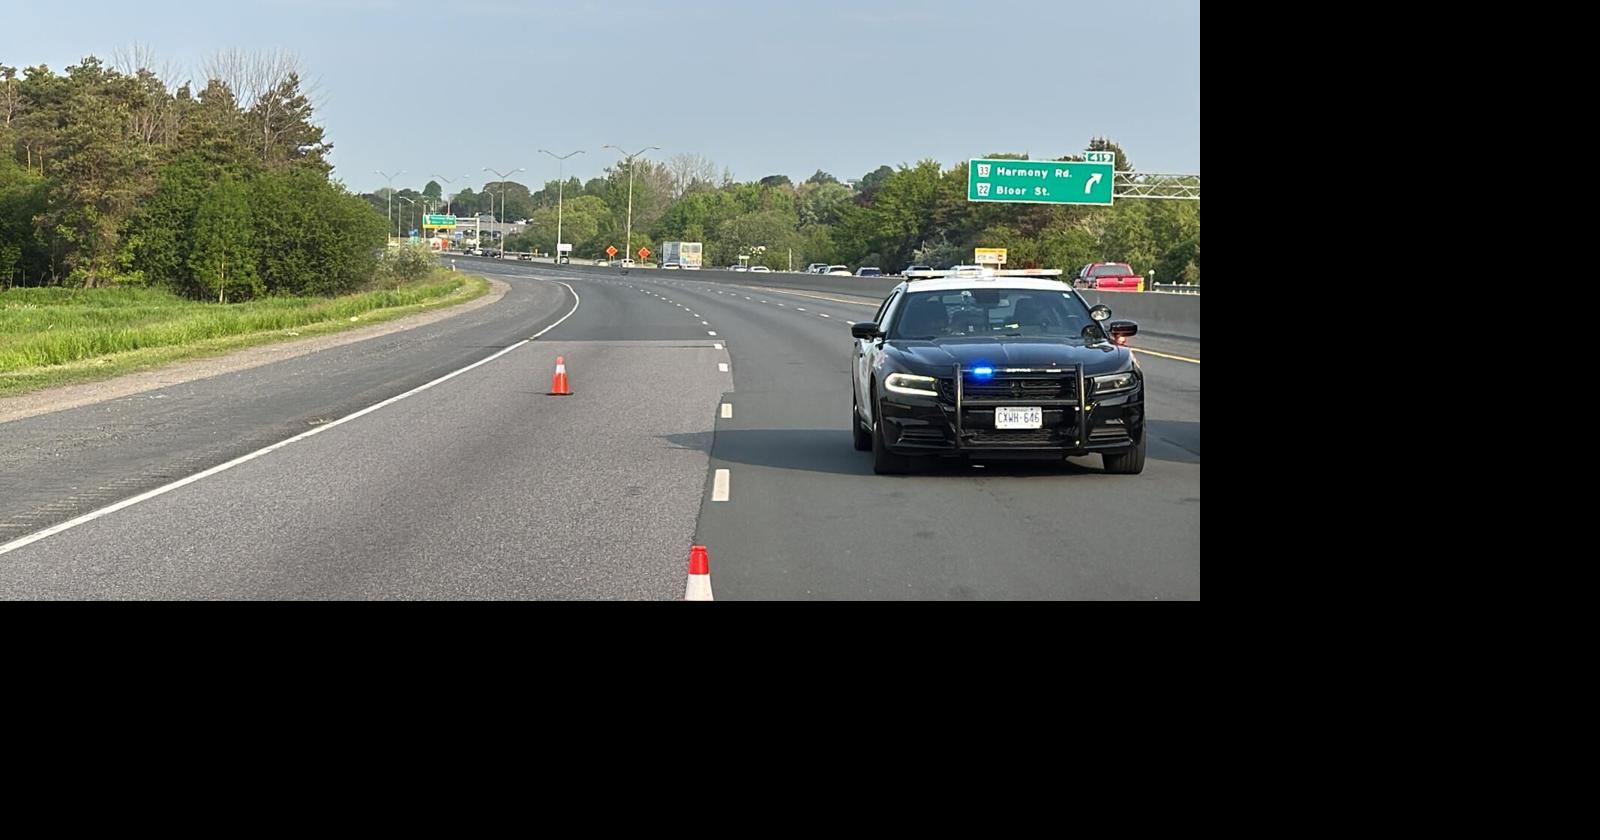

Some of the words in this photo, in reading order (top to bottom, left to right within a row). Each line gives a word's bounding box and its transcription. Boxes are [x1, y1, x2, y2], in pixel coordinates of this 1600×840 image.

[1089, 153, 1111, 162] 419
[979, 166, 989, 176] 33
[996, 167, 1048, 179] Harmony
[1055, 169, 1072, 178] Rd.
[979, 185, 988, 194] 22
[996, 186, 1027, 195] Bloor
[1034, 187, 1050, 196] St.
